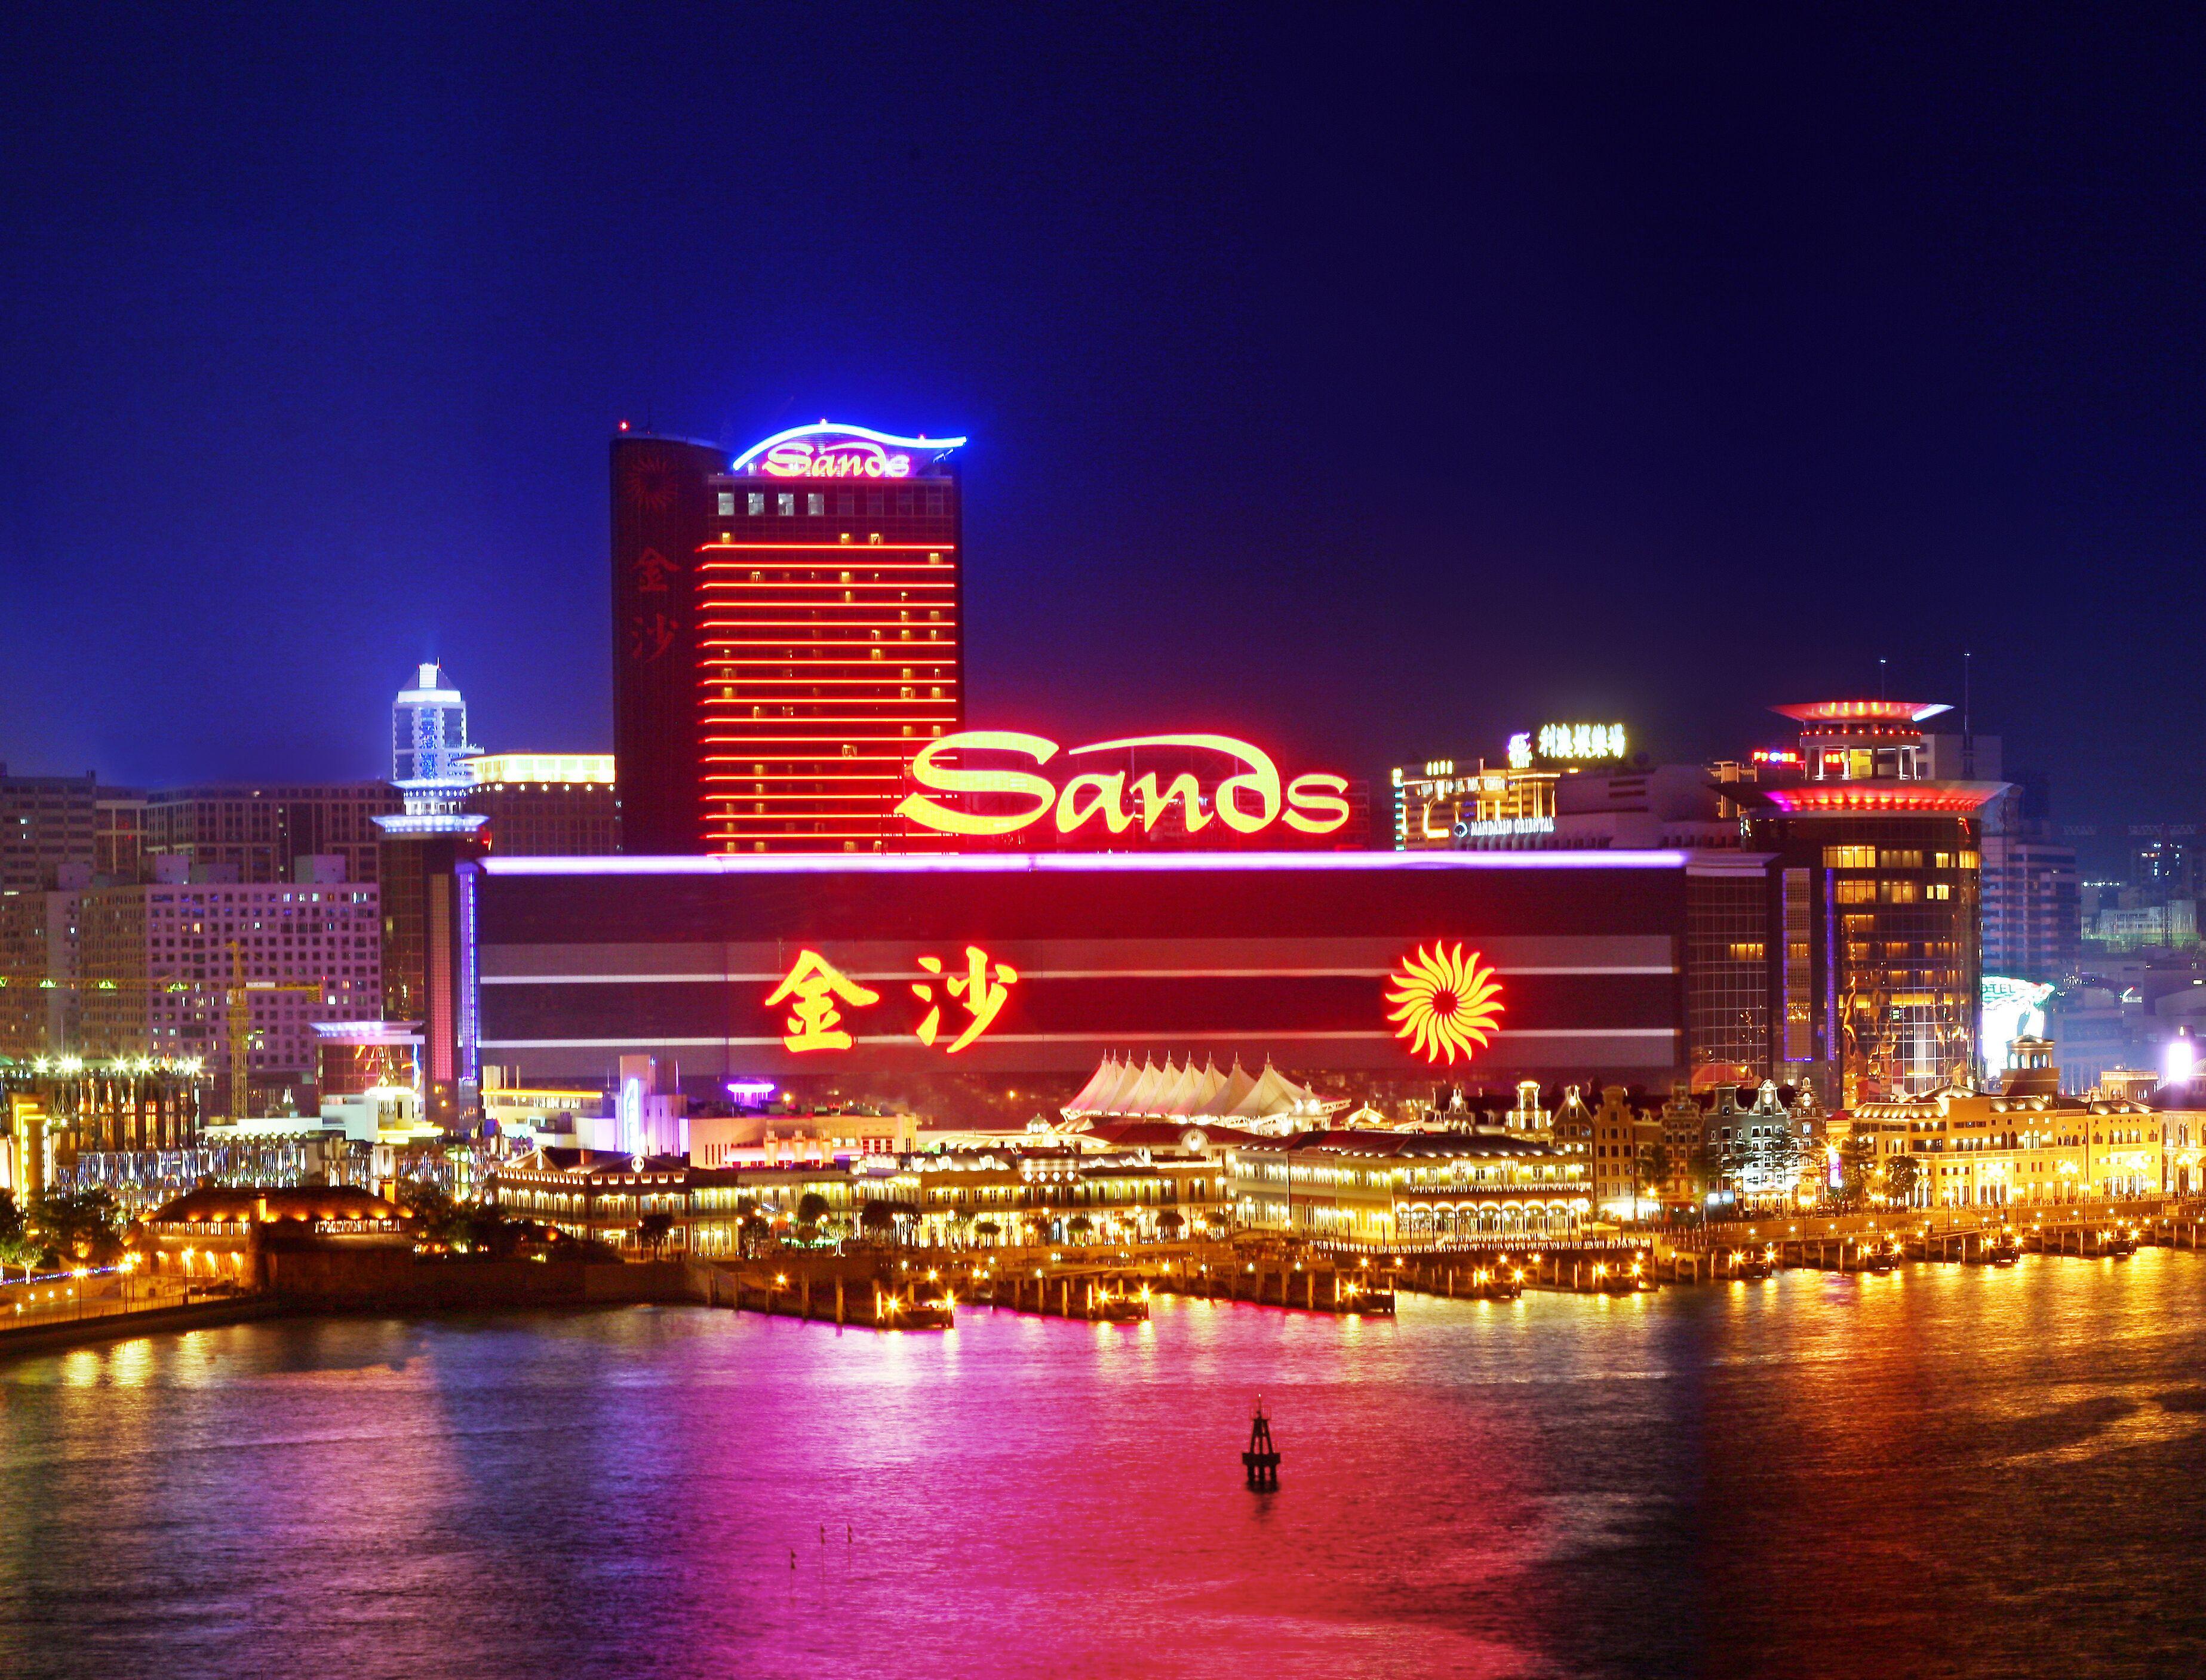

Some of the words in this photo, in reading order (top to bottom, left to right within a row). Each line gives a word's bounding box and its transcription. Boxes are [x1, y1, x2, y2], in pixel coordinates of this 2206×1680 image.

[761, 442, 910, 477] Sands
[630, 546, 681, 663] 金沙
[893, 731, 1350, 835] Sands
[1470, 819, 1513, 836] MANDARIN
[1514, 816, 1555, 834] ORIENTAL
[765, 946, 1018, 1053] 金沙
